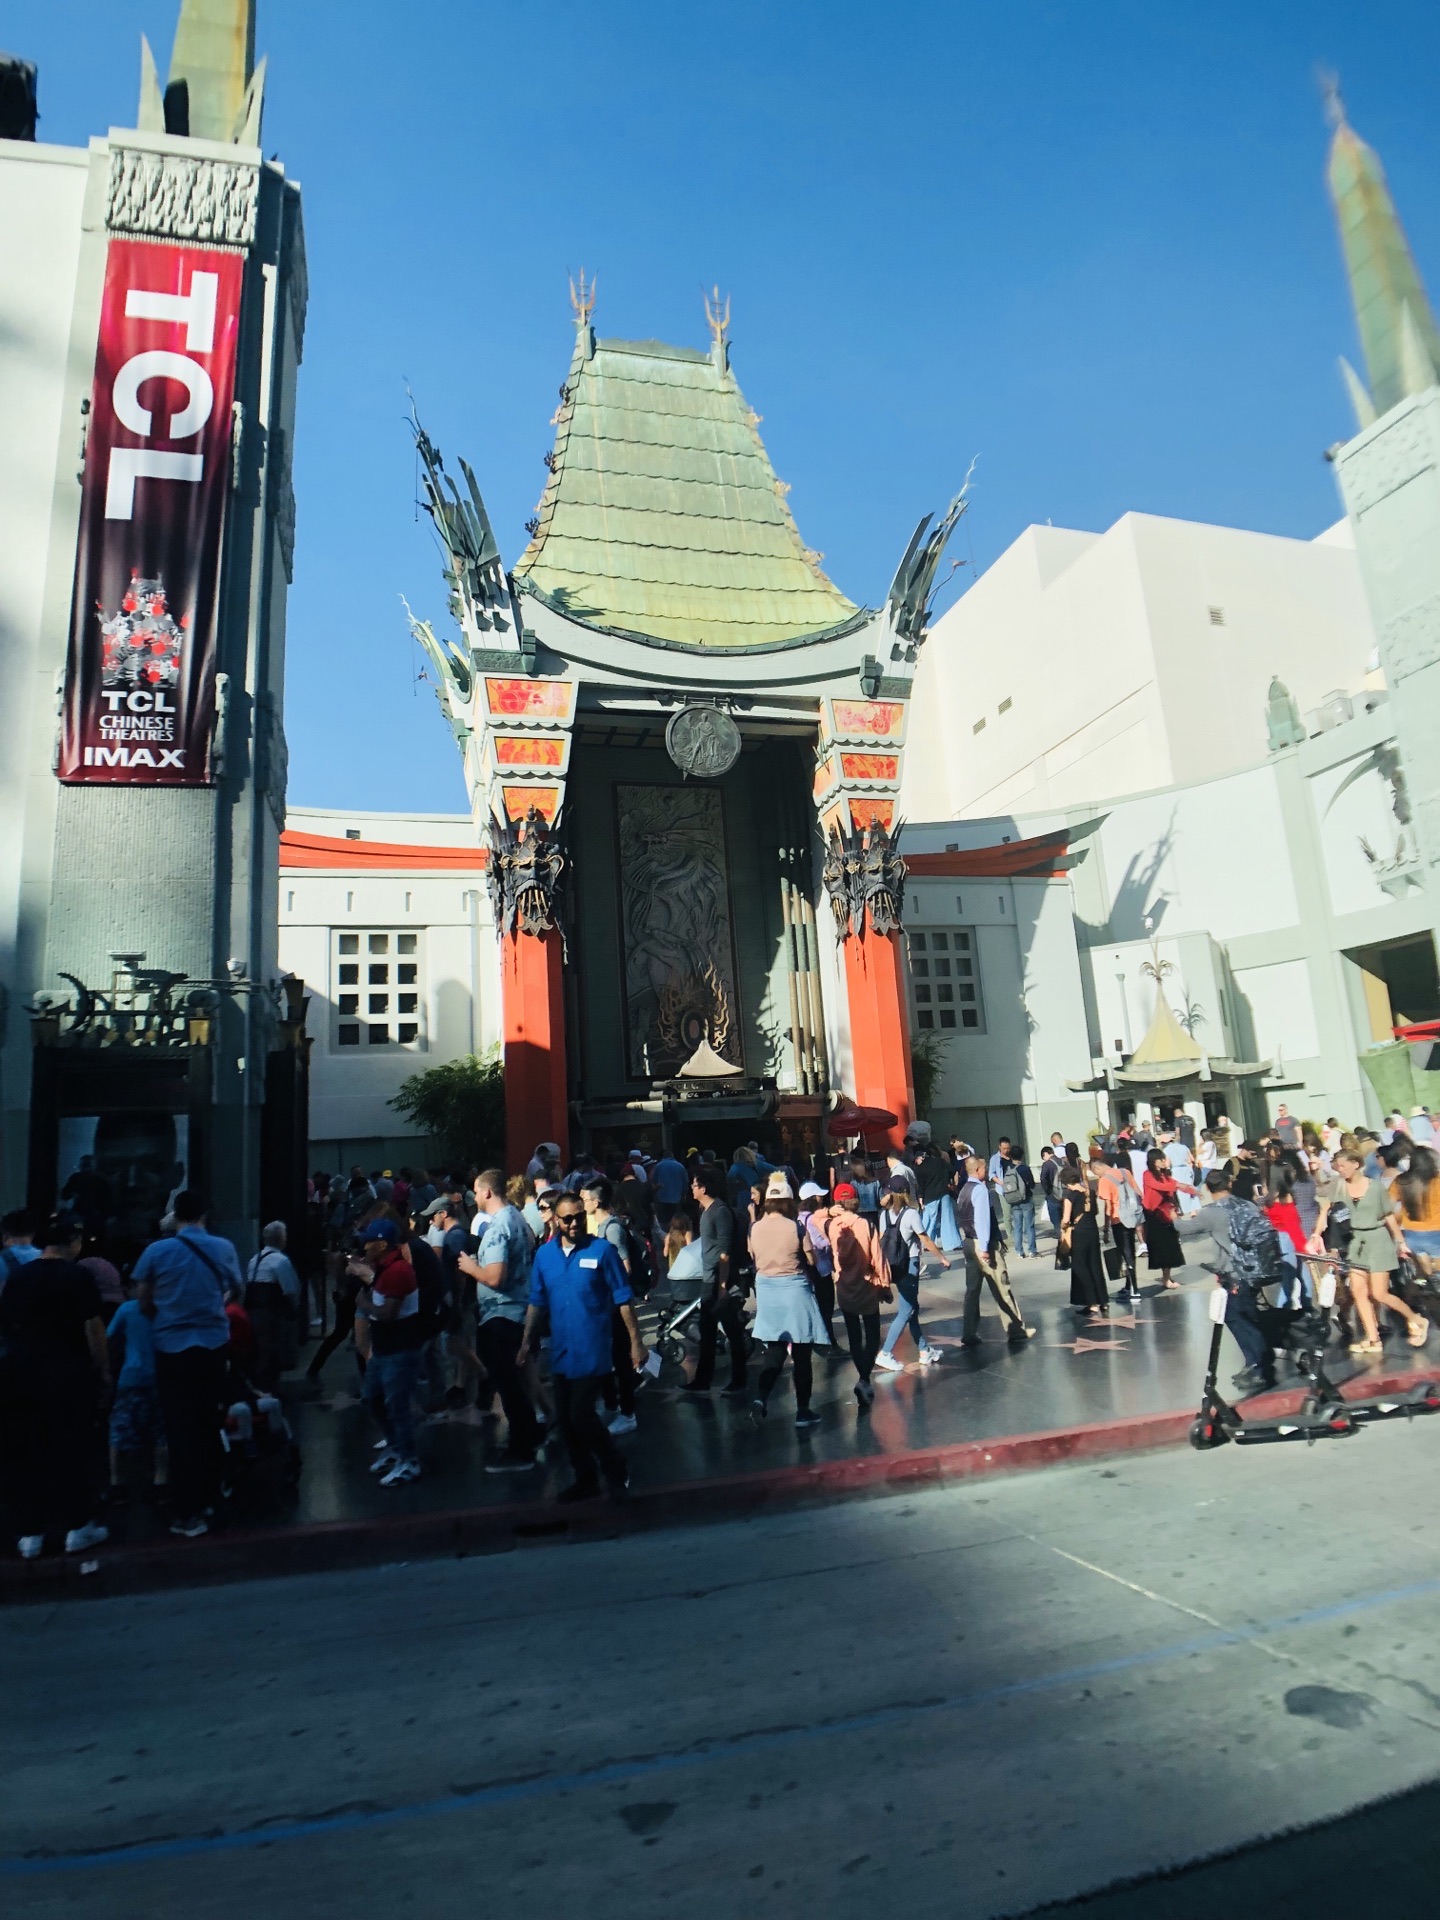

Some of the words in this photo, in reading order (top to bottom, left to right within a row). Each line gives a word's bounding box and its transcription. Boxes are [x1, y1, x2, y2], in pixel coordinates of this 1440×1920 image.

[105, 270, 219, 520] TCL
[101, 690, 176, 713] TCL
[99, 714, 175, 730] CHINESE
[99, 728, 175, 742] THEATRES
[83, 746, 186, 769] IMAX
